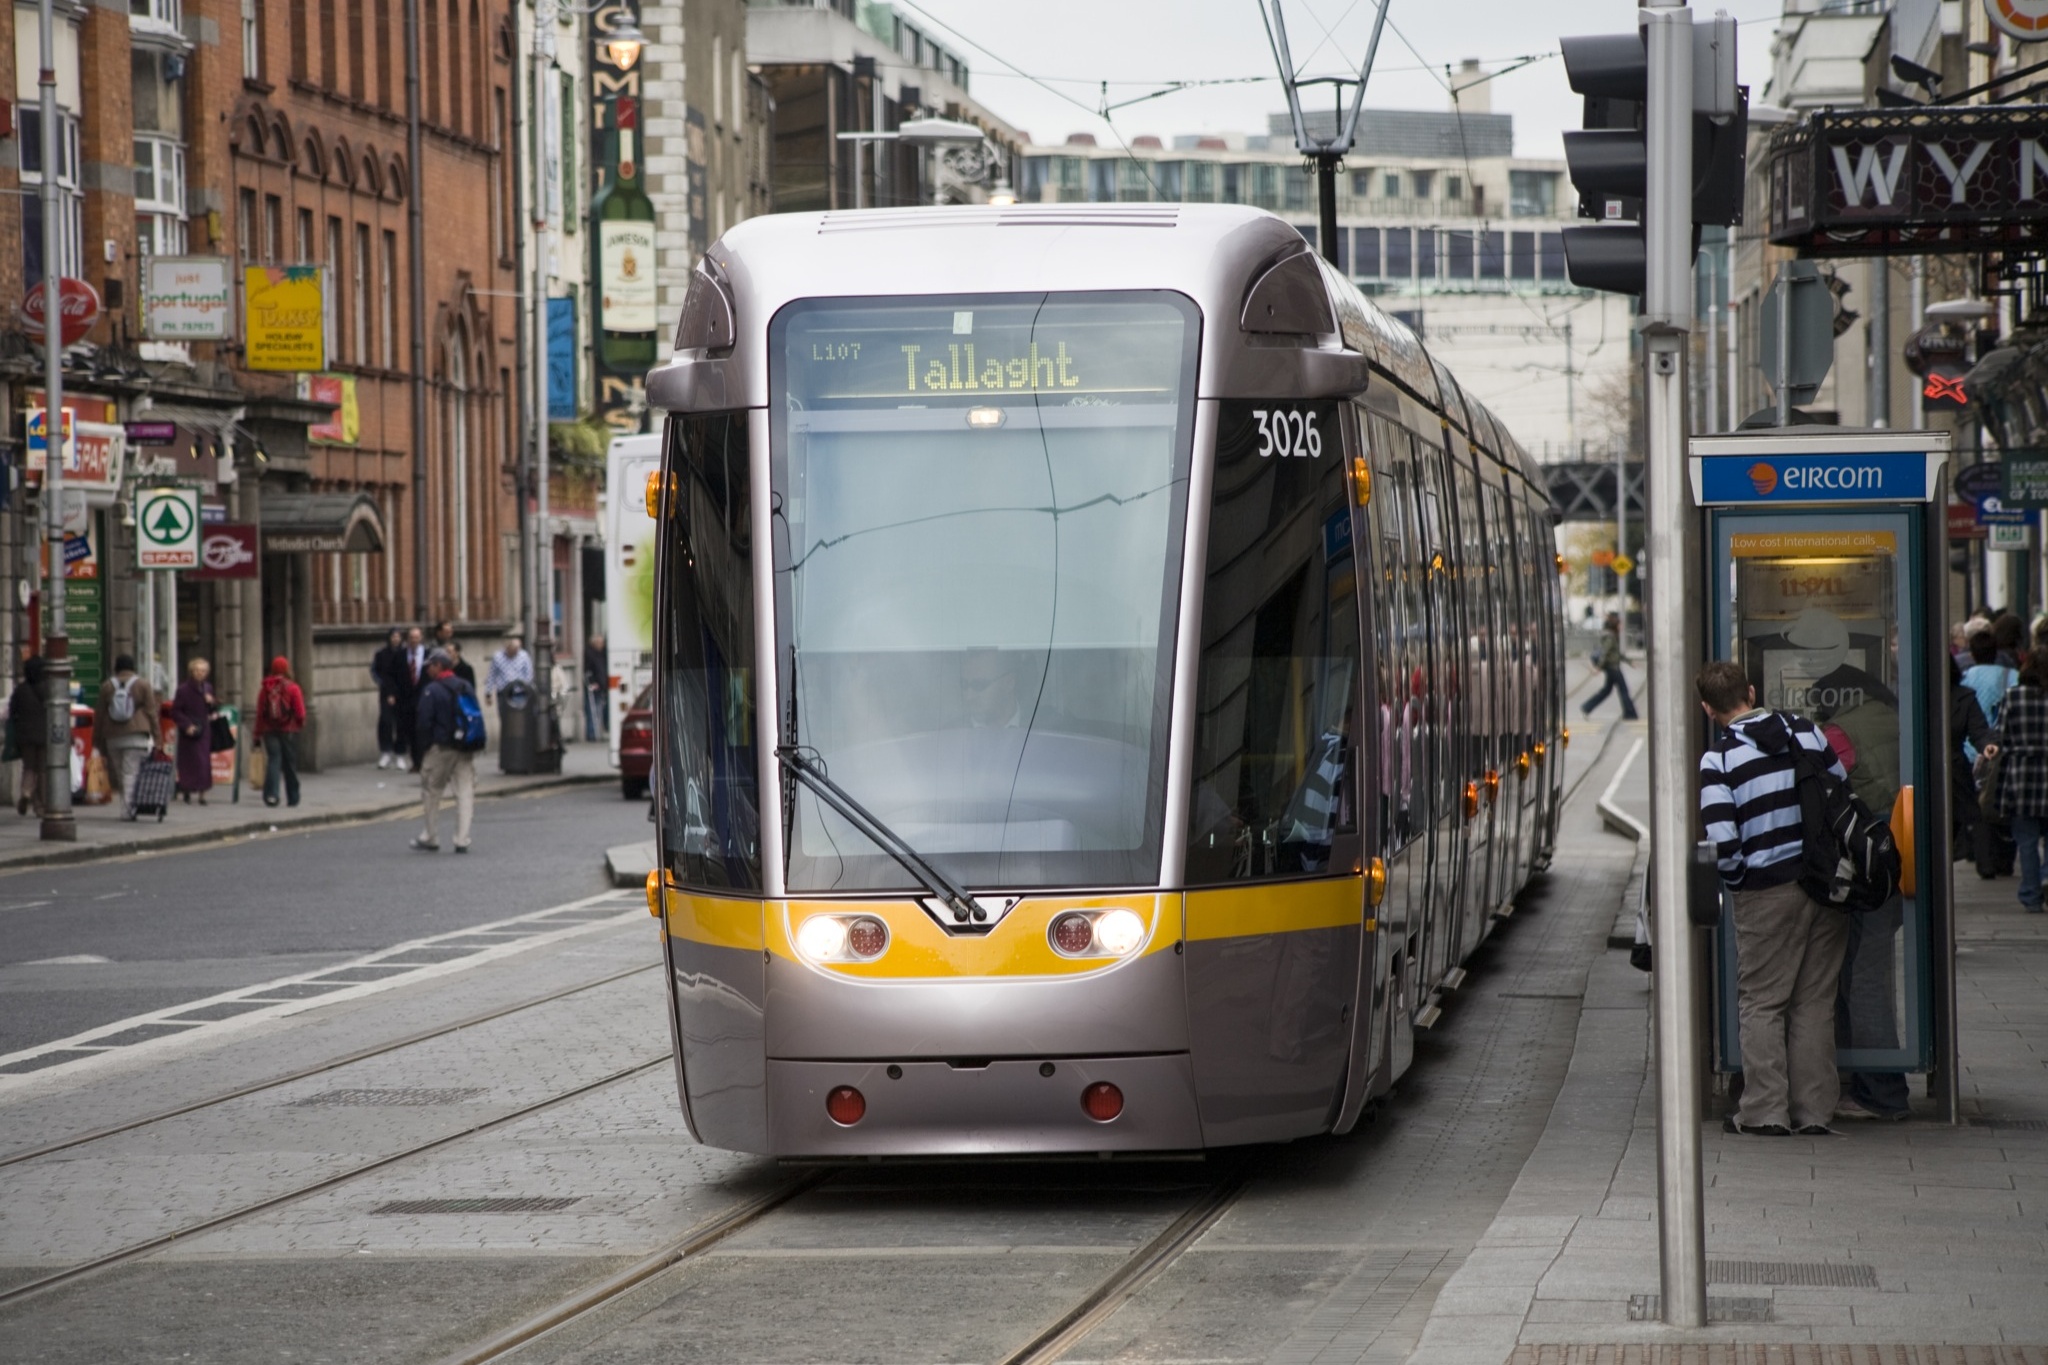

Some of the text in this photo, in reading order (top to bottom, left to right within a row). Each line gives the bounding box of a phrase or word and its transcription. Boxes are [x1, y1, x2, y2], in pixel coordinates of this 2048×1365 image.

[606, 232, 650, 248] JAMESON
[176, 273, 200, 287] just
[149, 289, 228, 313] portugal
[265, 333, 304, 341] HOLIDAY
[255, 342, 314, 351] SPECIALISTS
[812, 341, 1080, 390] L107 Tallaght
[30, 425, 70, 437] LOO
[1252, 410, 1322, 459] 3026
[266, 537, 345, 550] Methodist Church
[1734, 533, 1876, 548] Low cost International calls
[142, 552, 194, 564] SPAR
